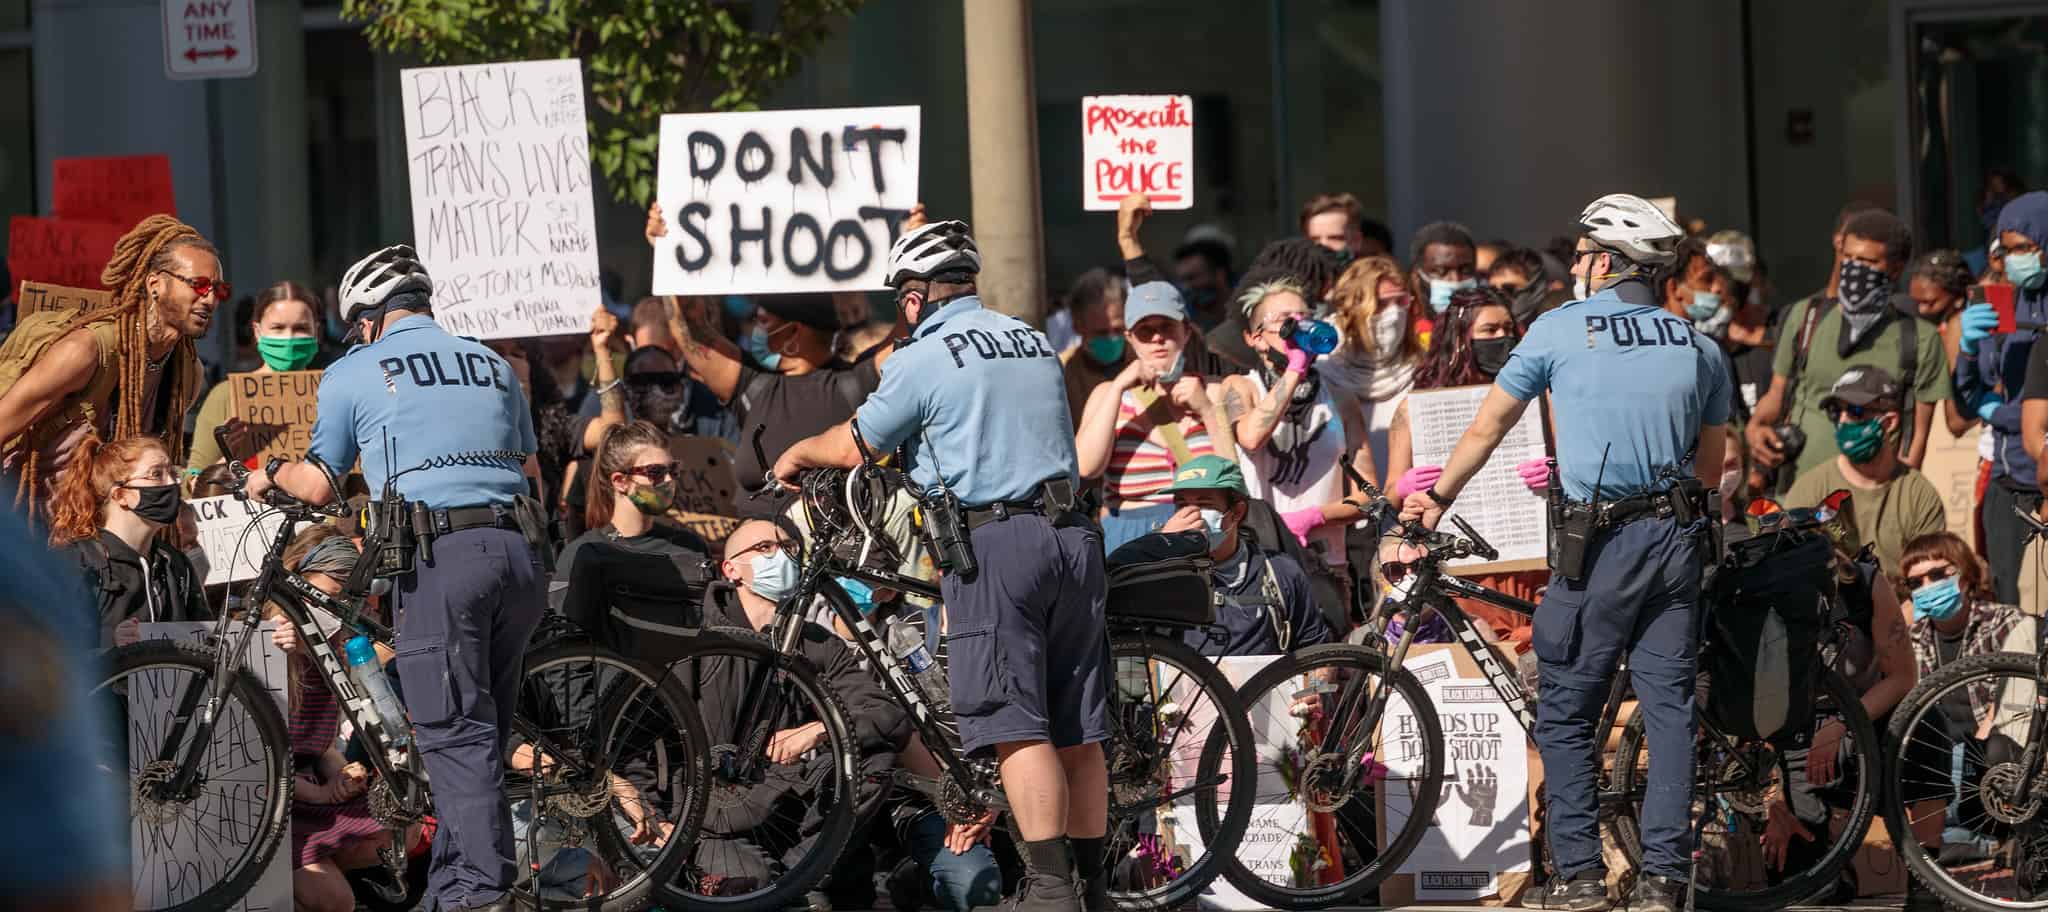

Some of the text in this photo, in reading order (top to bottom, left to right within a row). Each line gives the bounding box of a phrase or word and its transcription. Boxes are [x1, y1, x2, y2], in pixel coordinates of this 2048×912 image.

[183, 1, 233, 18] ANY
[183, 21, 235, 41] TIME
[1117, 137, 1157, 154] the
[413, 133, 592, 200] TRANS LIVES
[428, 199, 540, 263] MATTER
[378, 350, 509, 393] POLICE
[243, 373, 321, 398] DEFUN
[248, 403, 315, 425] POLIC
[1459, 619, 1536, 731] TREK
[1397, 712, 1499, 734] HDS UP
[1450, 738, 1502, 761] SHOOT
[1247, 859, 1284, 870] TRANS
